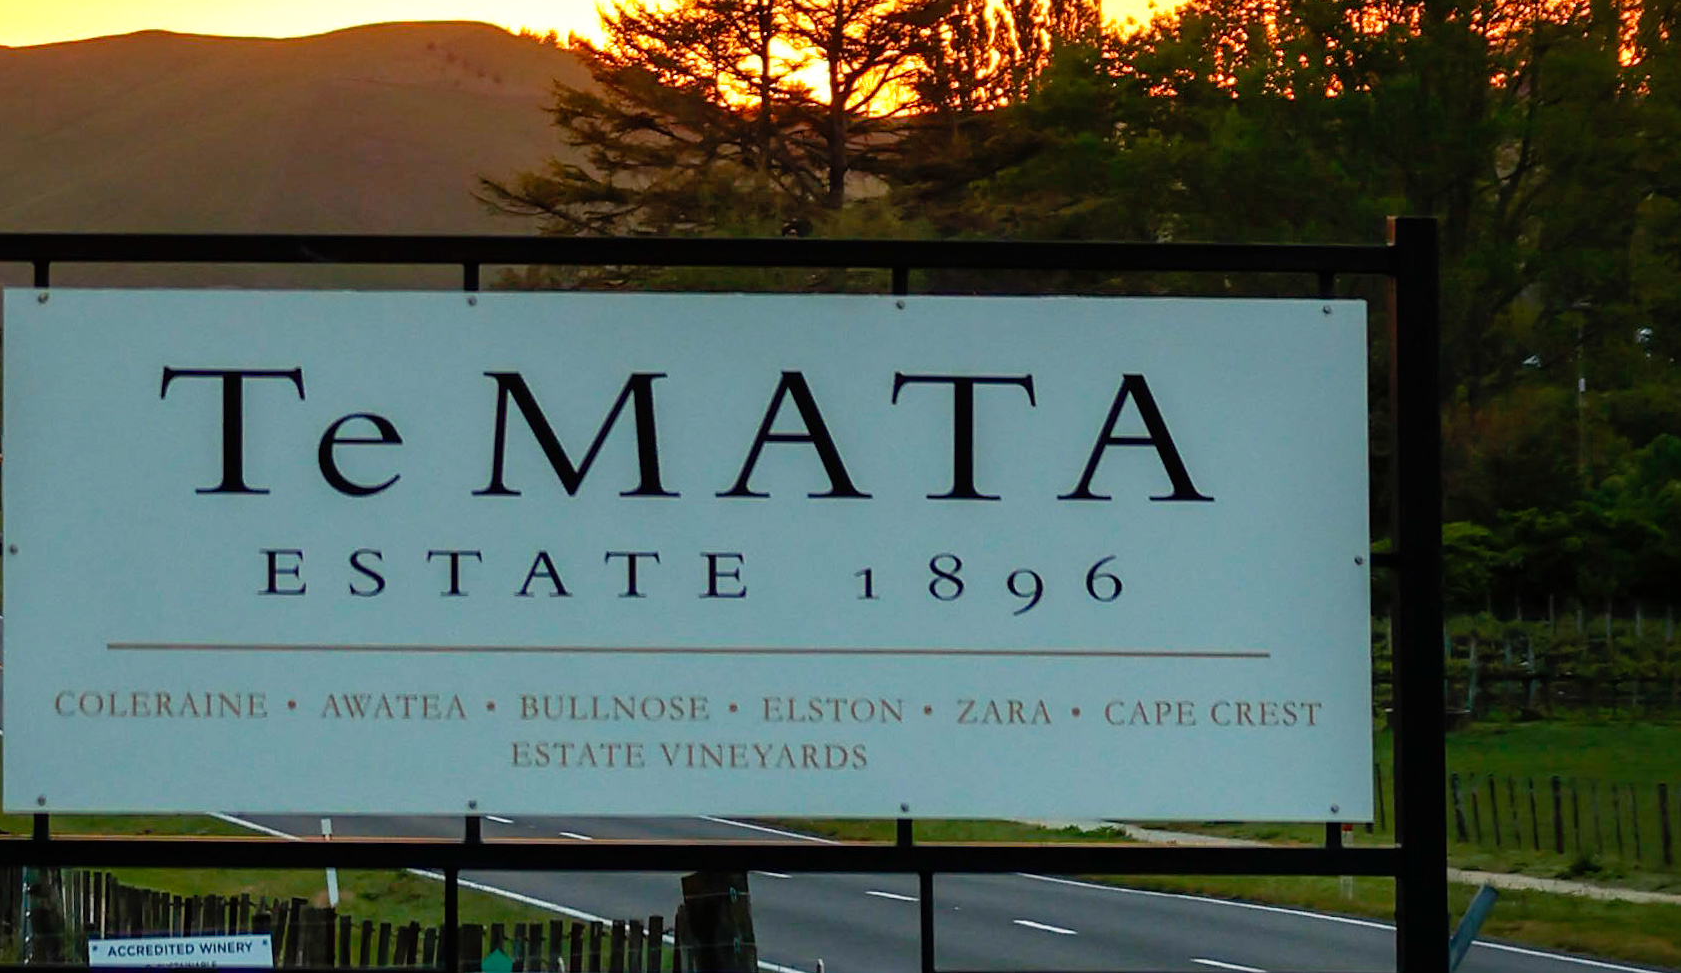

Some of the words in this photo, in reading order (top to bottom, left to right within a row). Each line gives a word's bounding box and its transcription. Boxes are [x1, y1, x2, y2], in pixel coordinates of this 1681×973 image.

[159, 365, 404, 498] Te
[471, 369, 1216, 502] MATA
[258, 548, 748, 599] ESTATE
[853, 553, 1124, 617] 1896
[54, 691, 268, 719] COLERAINE
[320, 693, 468, 720] AWATEA
[519, 694, 711, 721] BULLNOSE
[761, 697, 905, 723] ELSTON
[956, 699, 1053, 725] ZARA
[1104, 700, 1197, 726] CAPE
[1210, 701, 1323, 727] CREST
[511, 742, 646, 768] ESTATE
[659, 743, 869, 770] VINEYARDS
[107, 943, 195, 957] ACCREDITED
[199, 941, 253, 955] WINERY
